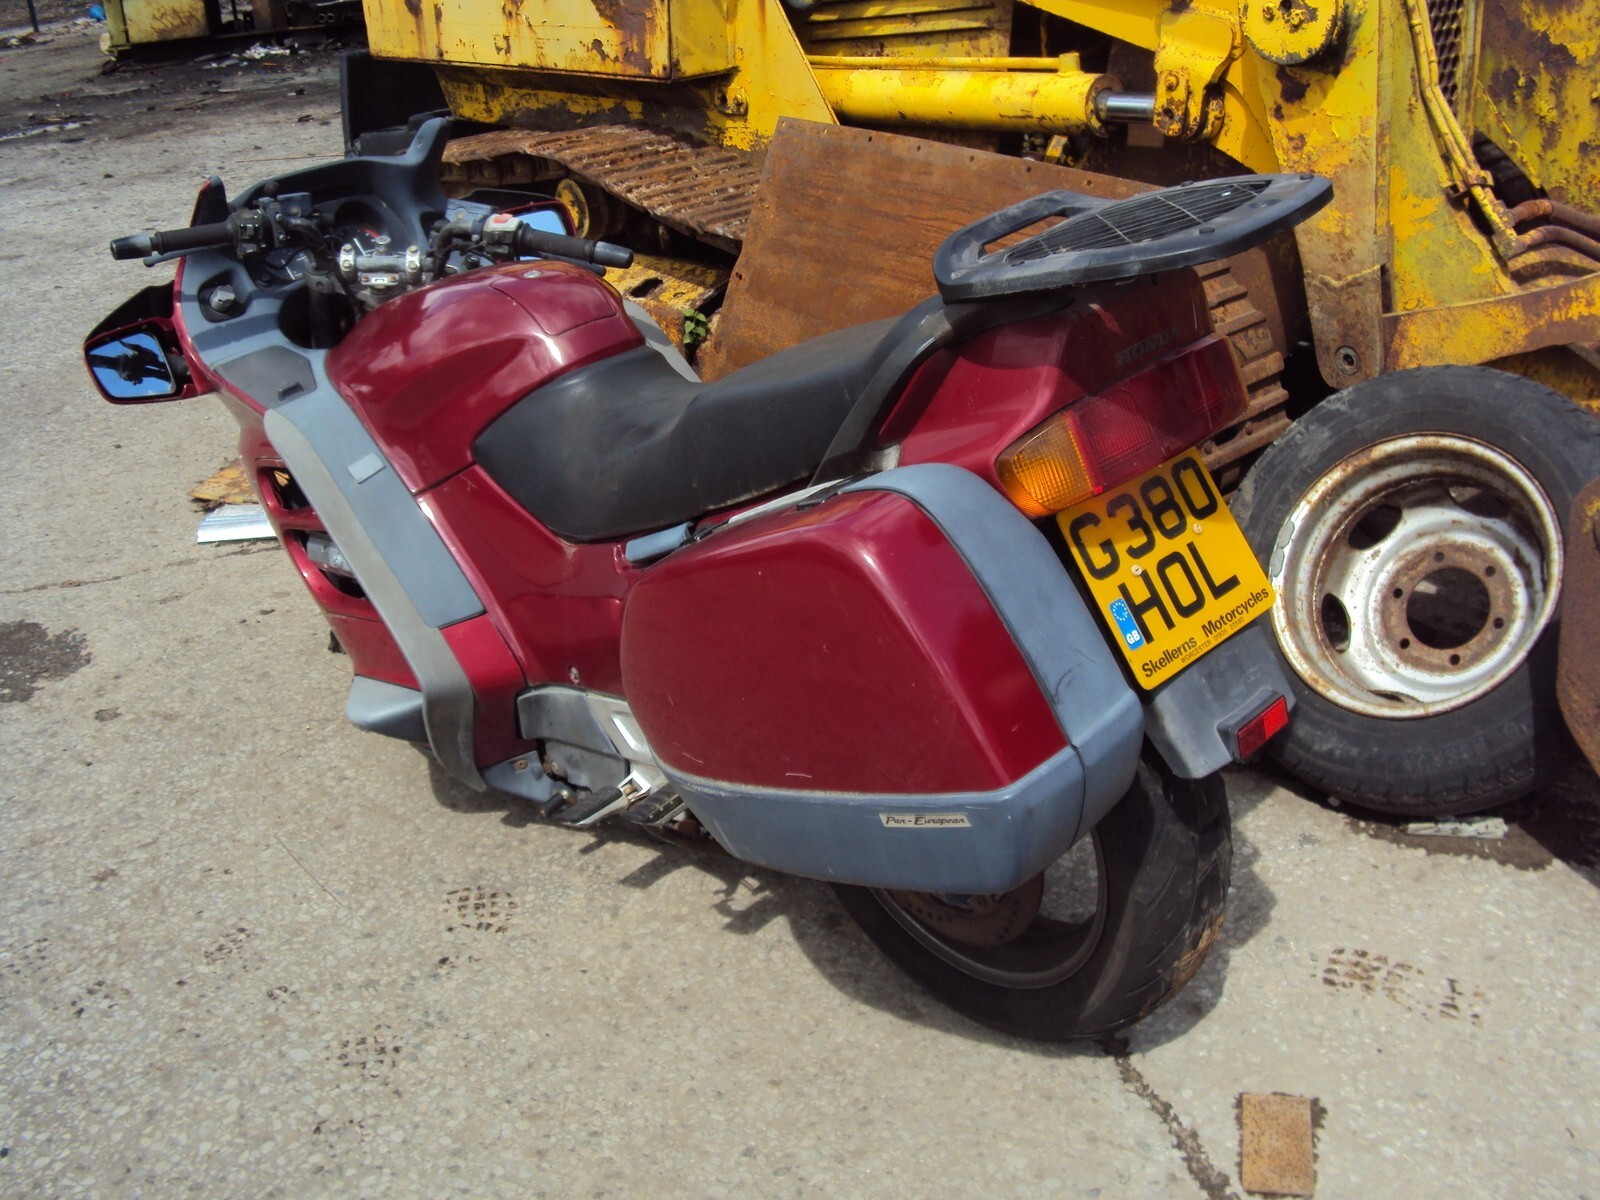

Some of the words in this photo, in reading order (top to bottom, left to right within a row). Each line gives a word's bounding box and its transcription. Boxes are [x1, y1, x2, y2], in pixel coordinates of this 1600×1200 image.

[1115, 326, 1181, 368] HONDA
[1070, 456, 1218, 581] G380
[1117, 541, 1241, 645] HOL
[1126, 629, 1141, 645] GB
[1141, 636, 1198, 678] Skellerns
[1201, 588, 1270, 638] Motorcycles
[1181, 639, 1212, 664] WORCESTER
